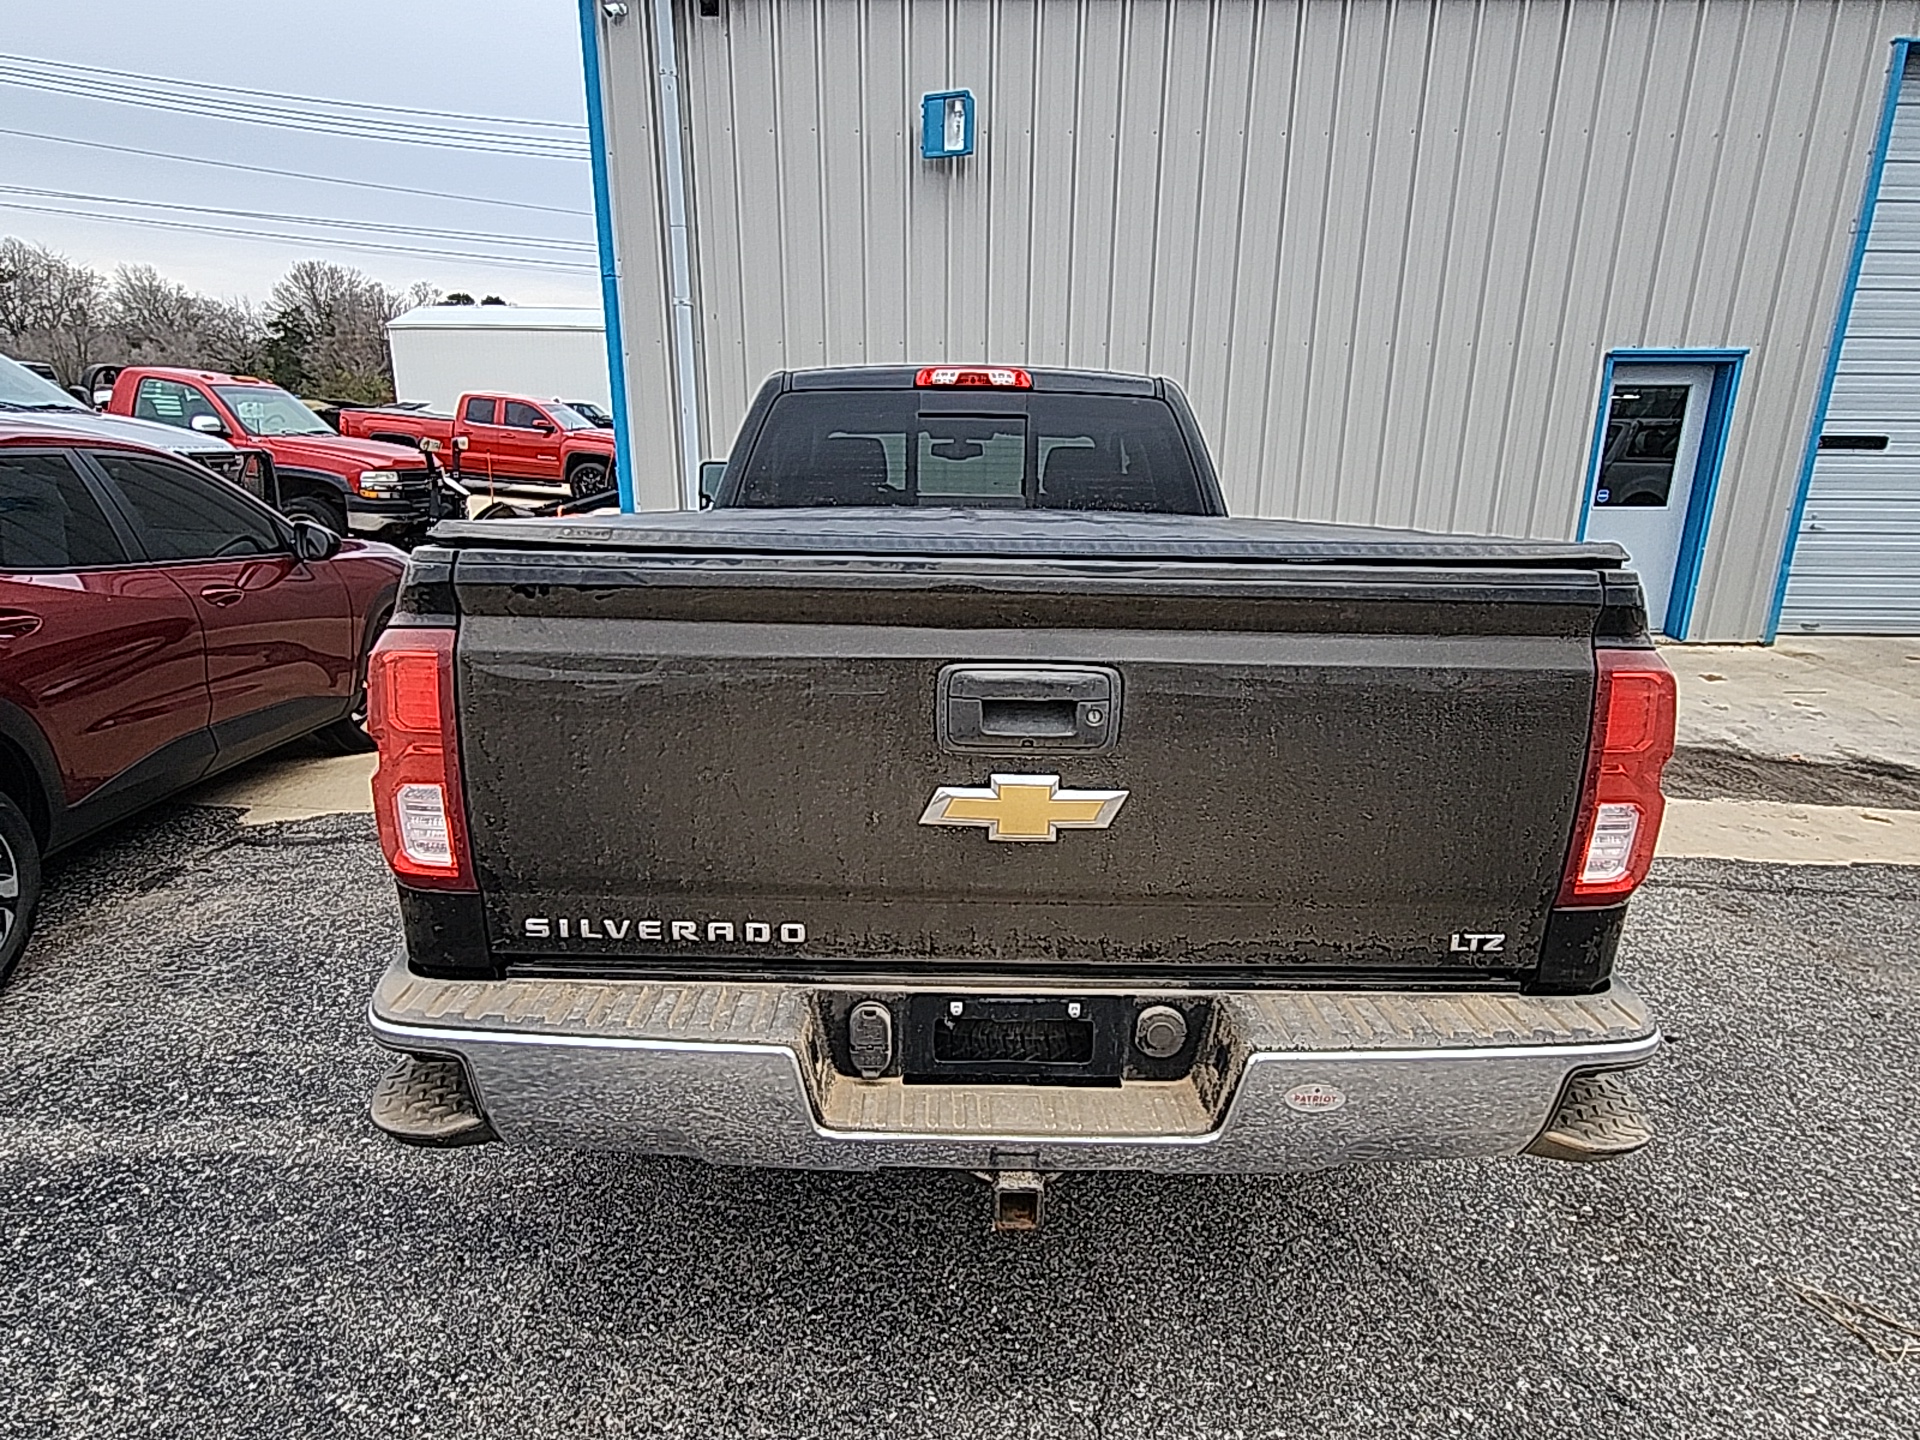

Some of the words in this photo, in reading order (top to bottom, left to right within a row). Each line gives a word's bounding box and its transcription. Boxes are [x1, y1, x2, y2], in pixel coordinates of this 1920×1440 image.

[525, 918, 806, 943] SILVERADO
[1450, 933, 1506, 952] LTZ
[1294, 1094, 1337, 1103] PATRIOT
